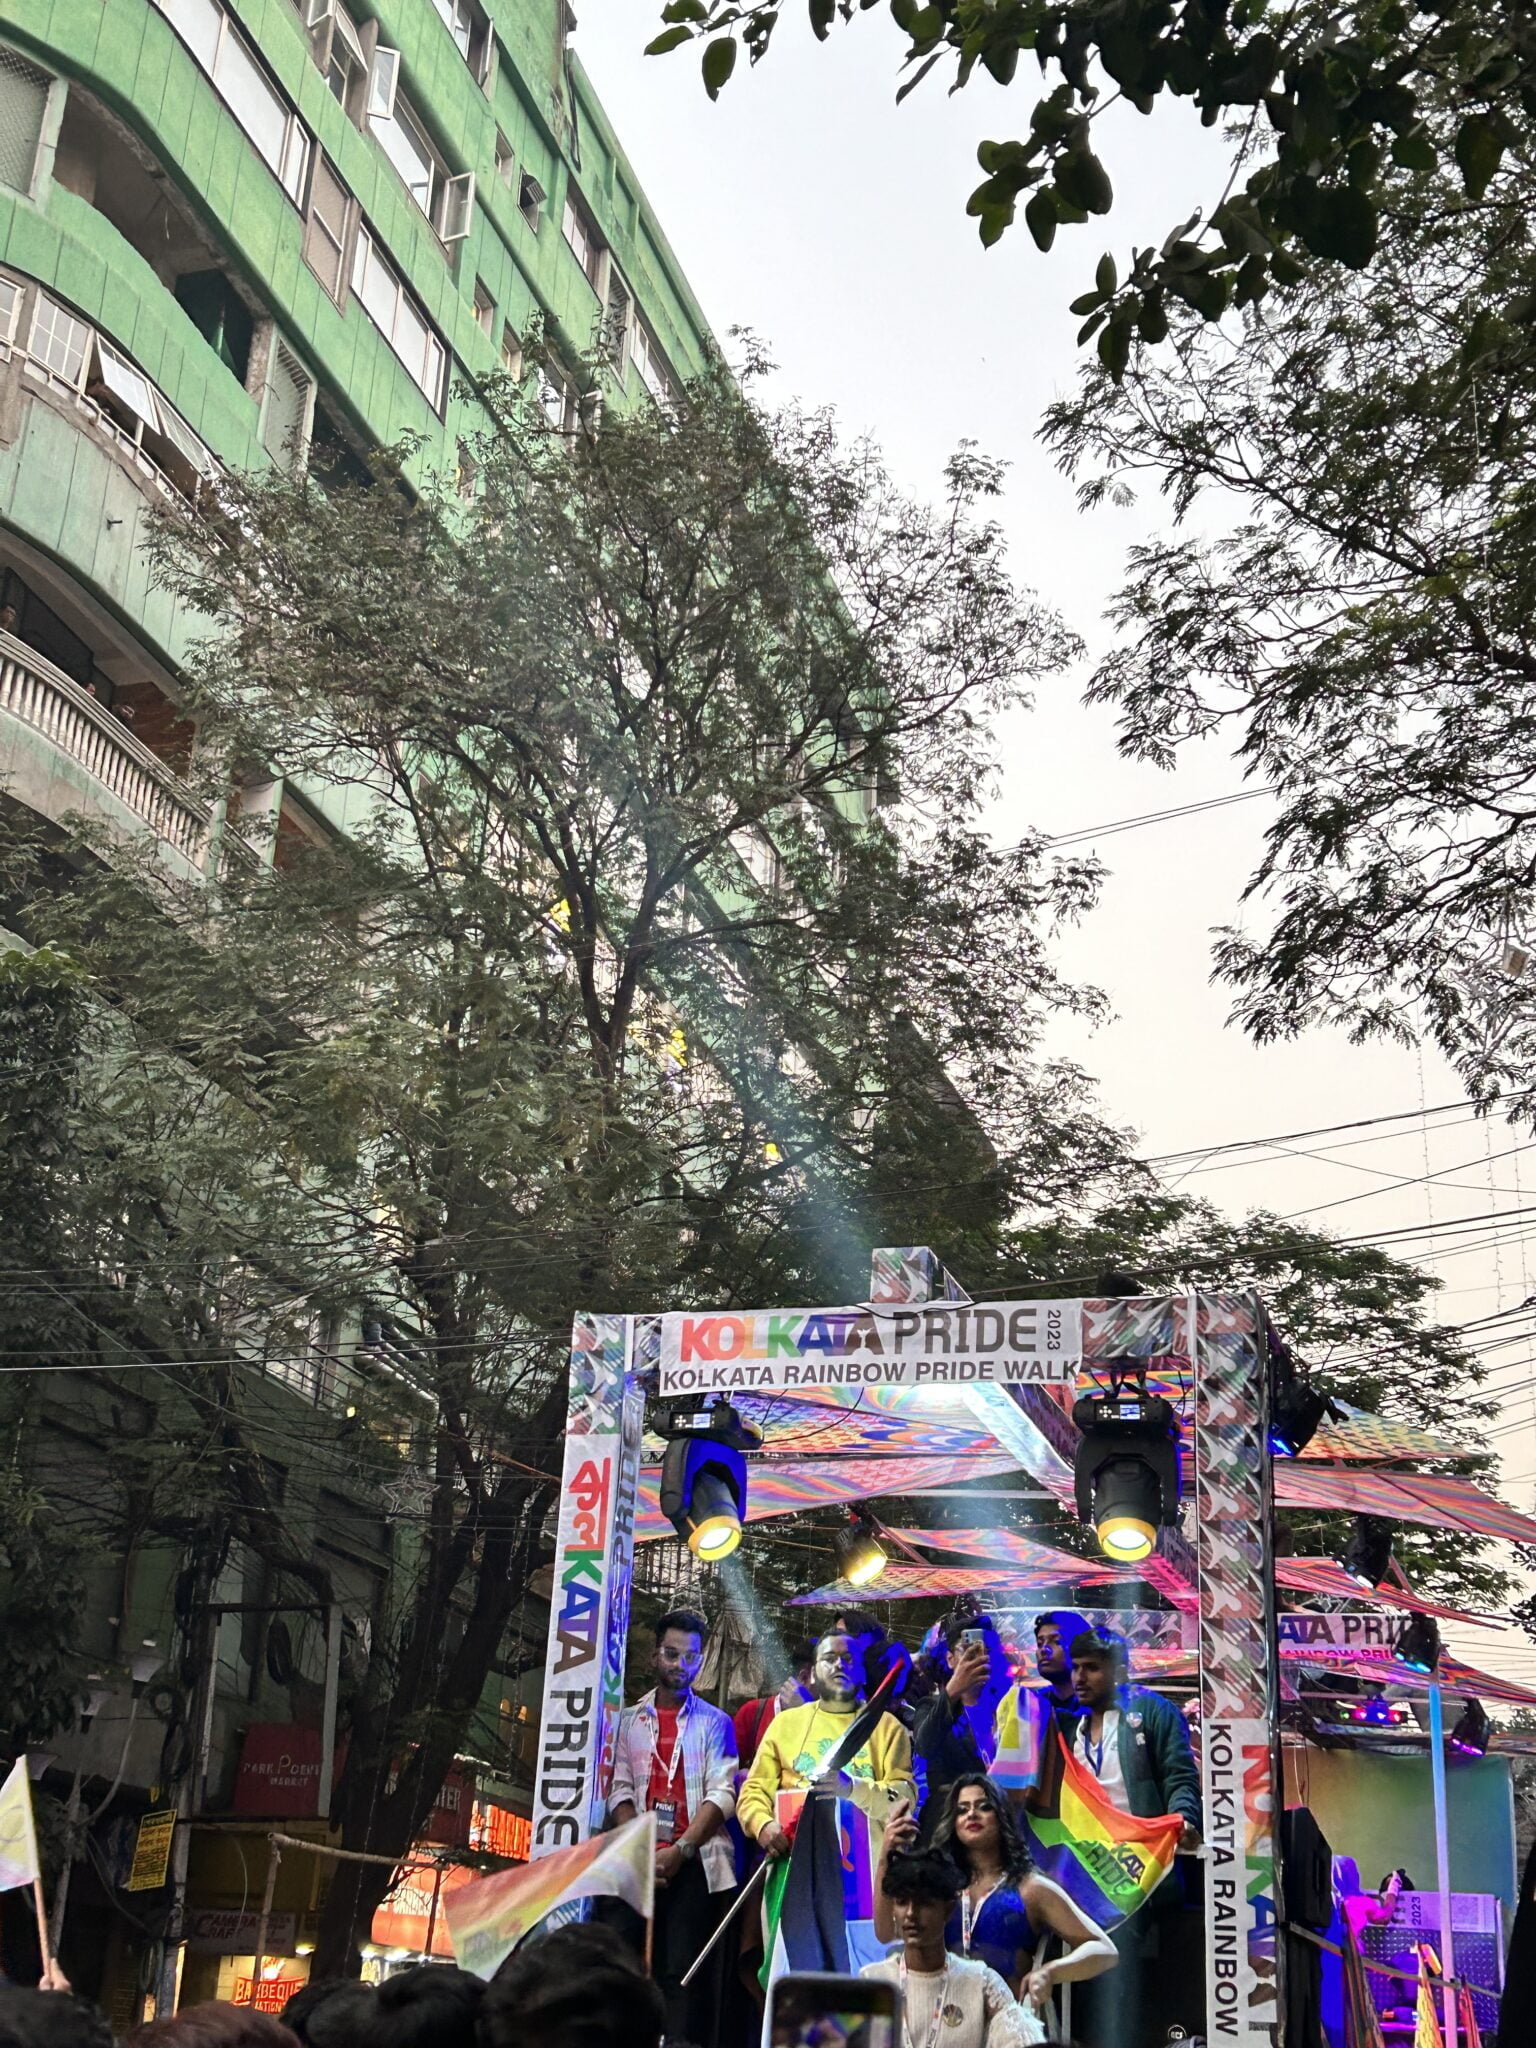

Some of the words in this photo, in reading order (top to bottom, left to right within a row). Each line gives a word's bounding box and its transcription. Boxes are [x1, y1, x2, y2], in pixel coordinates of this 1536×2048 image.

[681, 1311, 885, 1362] KOLKATA
[893, 1308, 1037, 1354] PRIDE
[1047, 1310, 1061, 1350] 2023
[663, 1366, 774, 1390] KOLKATA
[784, 1362, 906, 1384] RAINBOW
[916, 1361, 994, 1380] PRIDE
[1005, 1361, 1079, 1380] WALK
[1279, 1615, 1335, 1643] ATA
[536, 1687, 592, 1845] PRIDE
[1210, 1724, 1235, 1867] KOLKATA
[1214, 1879, 1238, 2036] RAINBOW
